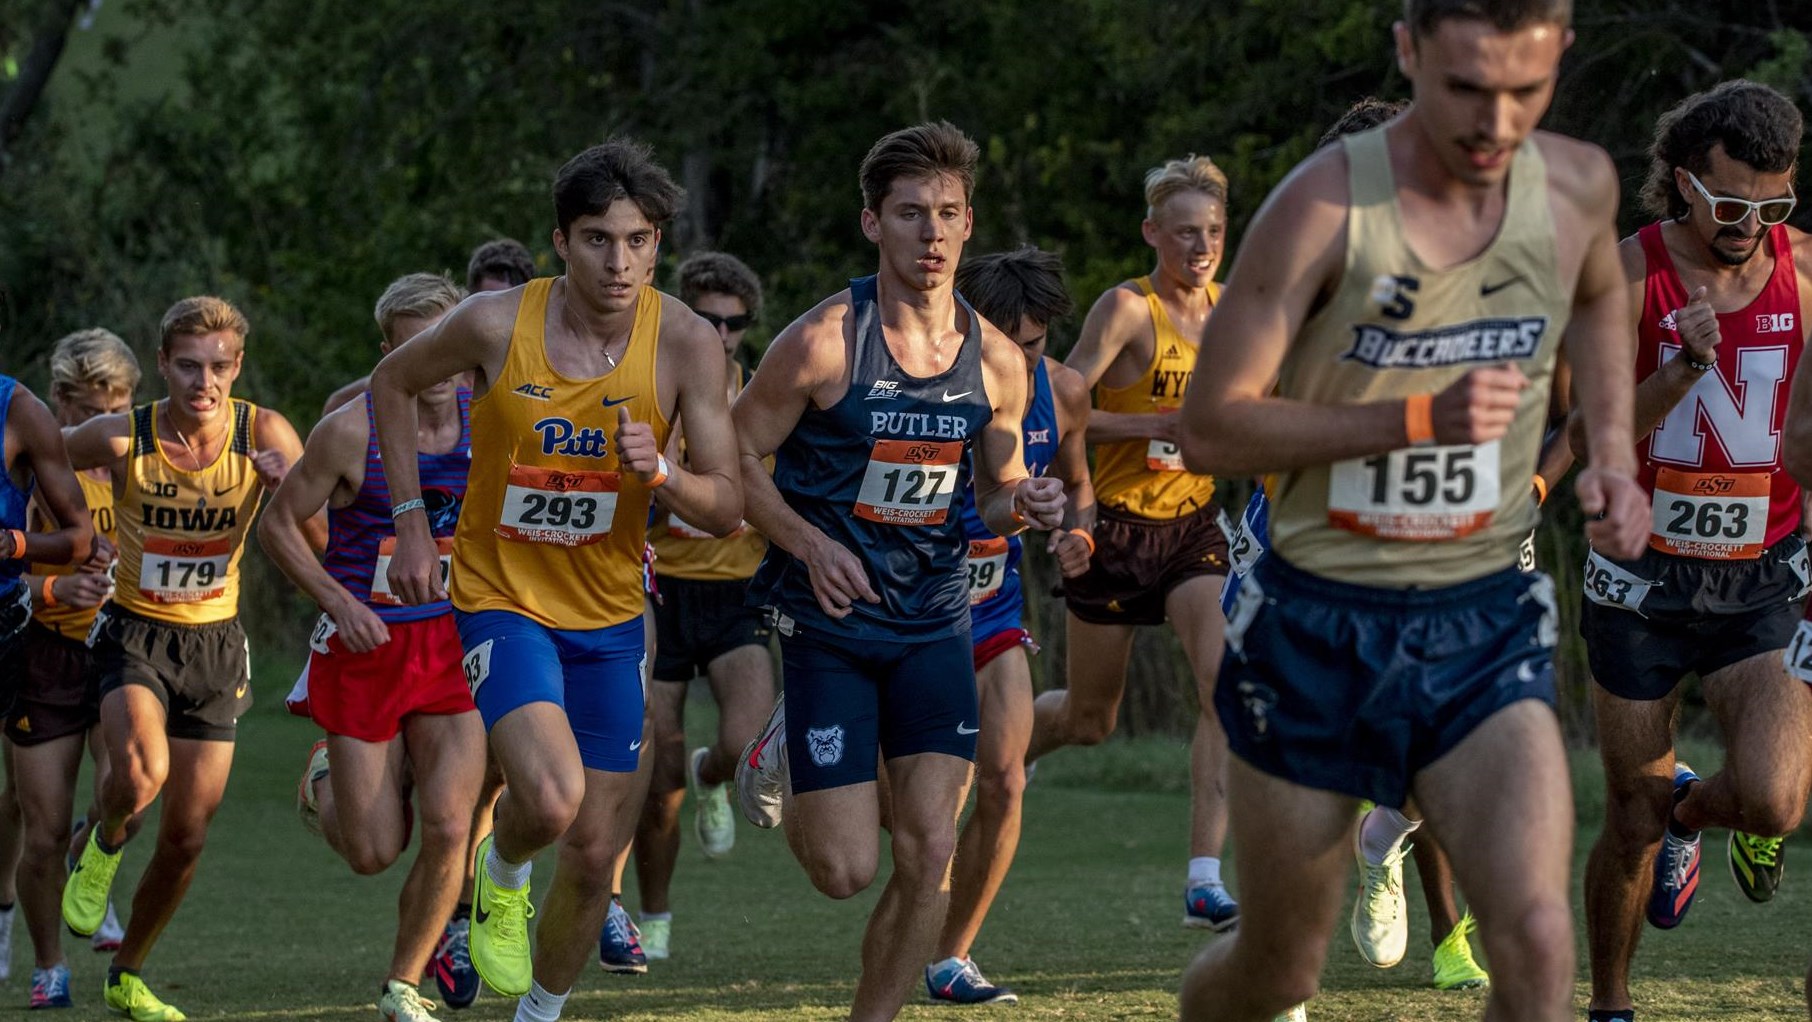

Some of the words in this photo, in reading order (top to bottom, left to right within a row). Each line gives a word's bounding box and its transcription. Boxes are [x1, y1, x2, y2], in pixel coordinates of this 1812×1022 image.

[1353, 318, 1545, 367] BUCCANEERS
[514, 383, 554, 399] ACC
[868, 389, 902, 398] EAST
[873, 380, 899, 389] BIG
[1649, 342, 1789, 467] N
[533, 416, 608, 459] Pitt
[870, 411, 968, 439] BUTLER
[904, 443, 940, 463] OSU
[883, 468, 947, 505] 127
[1364, 450, 1475, 505] 155
[1692, 475, 1736, 496] OSU
[142, 503, 237, 531] IOWA
[518, 493, 597, 529] 293
[873, 506, 937, 518] WEIS-CROCKETT
[882, 515, 925, 524] INVITATIONAL
[1666, 500, 1749, 539] 263
[517, 528, 592, 541] WEIS-CROCKETT
[528, 536, 578, 546] INVITATIONAL
[1665, 538, 1744, 552] WEIS-CROCKETT
[1677, 547, 1731, 558] INVITATIONAL
[157, 560, 216, 588] 179
[1586, 558, 1632, 604] 263
[464, 653, 481, 692] 93
